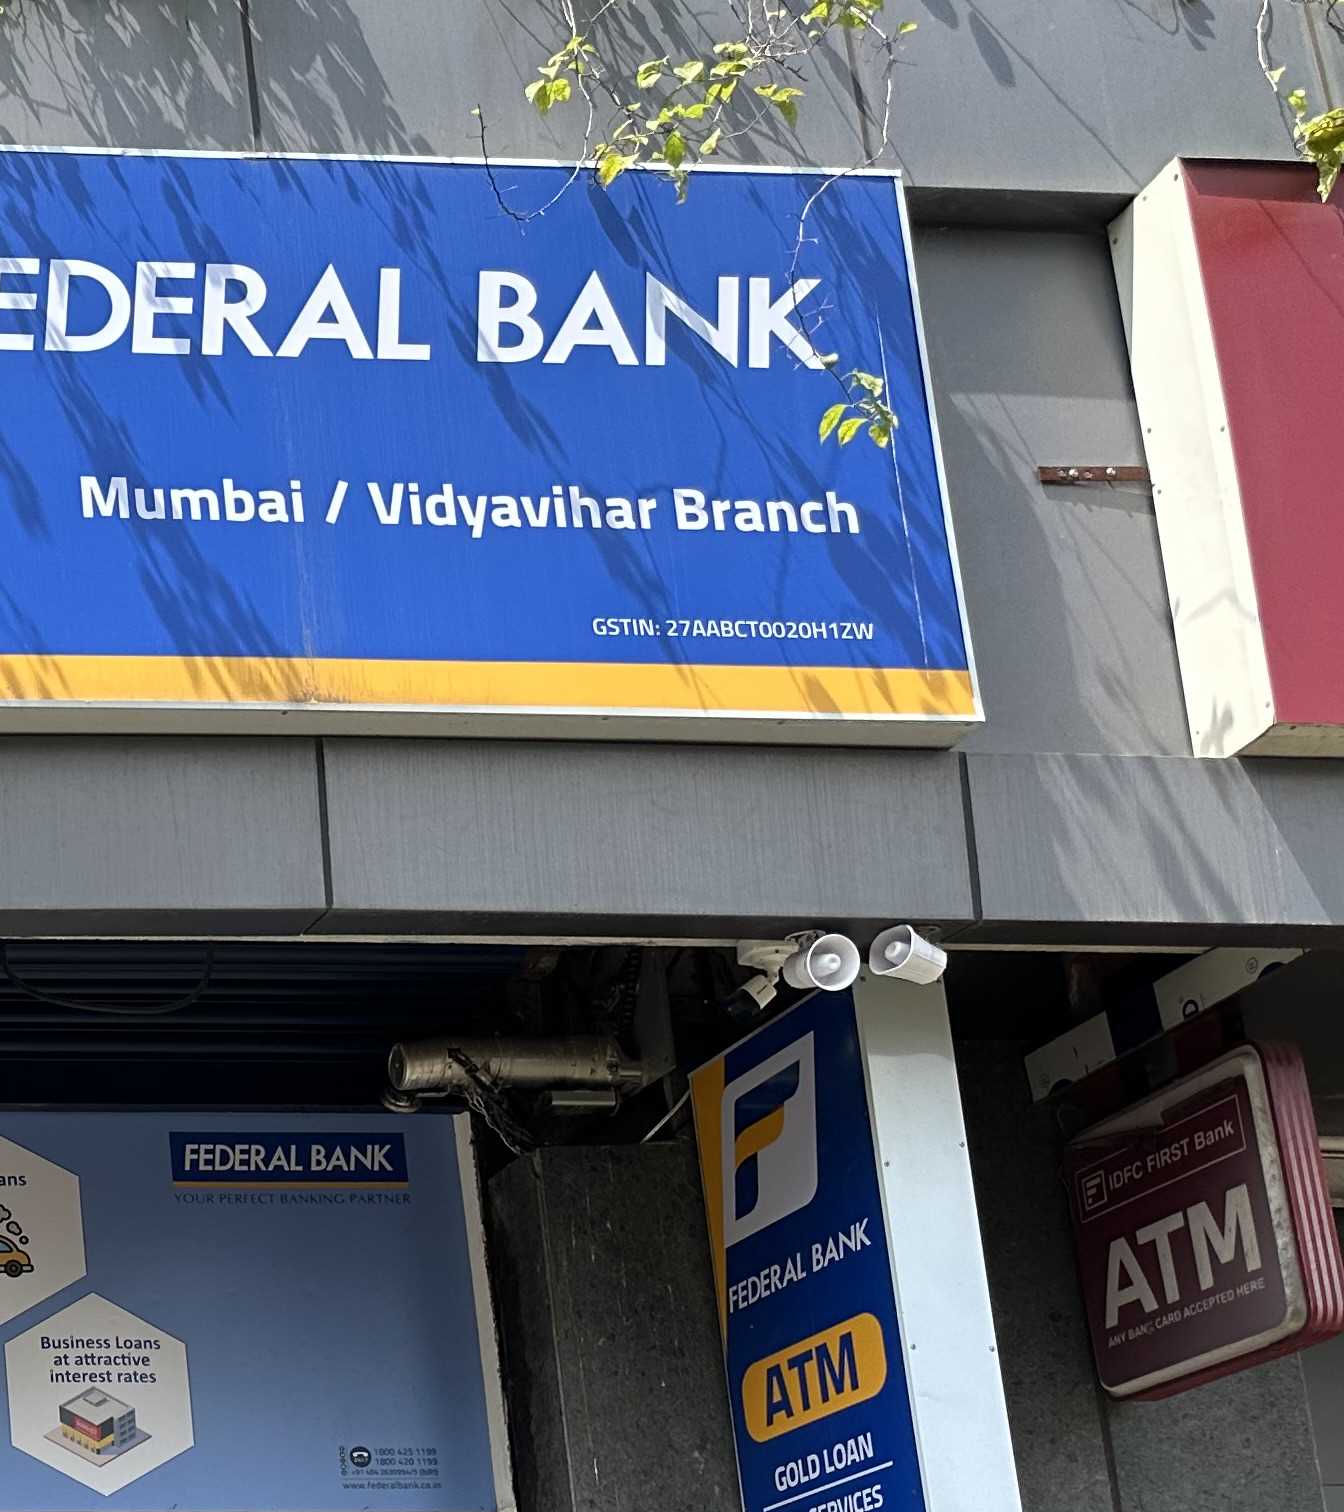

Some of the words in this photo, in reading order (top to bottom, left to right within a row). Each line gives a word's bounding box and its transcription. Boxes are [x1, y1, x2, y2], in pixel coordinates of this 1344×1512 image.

[477, 270, 830, 371] BANK
[80, 475, 303, 525] Mumbai
[326, 480, 348, 525] /
[367, 482, 658, 539] Vidyavihar
[674, 488, 859, 535] Branch
[592, 618, 660, 636] GSTIN:
[184, 1144, 303, 1171] FEDERAL
[311, 1144, 393, 1171] BANK
[1109, 1164, 1143, 1192] IDFC
[1147, 1141, 1189, 1177] FIRST
[1194, 1119, 1234, 1153] Bank
[729, 1255, 806, 1313] FEDERAL
[812, 1218, 871, 1272] BANK
[1105, 1183, 1262, 1329] ATM
[766, 1332, 861, 1426] ATM
[774, 1453, 819, 1491] GOLD
[824, 1432, 873, 1473] LOAN
